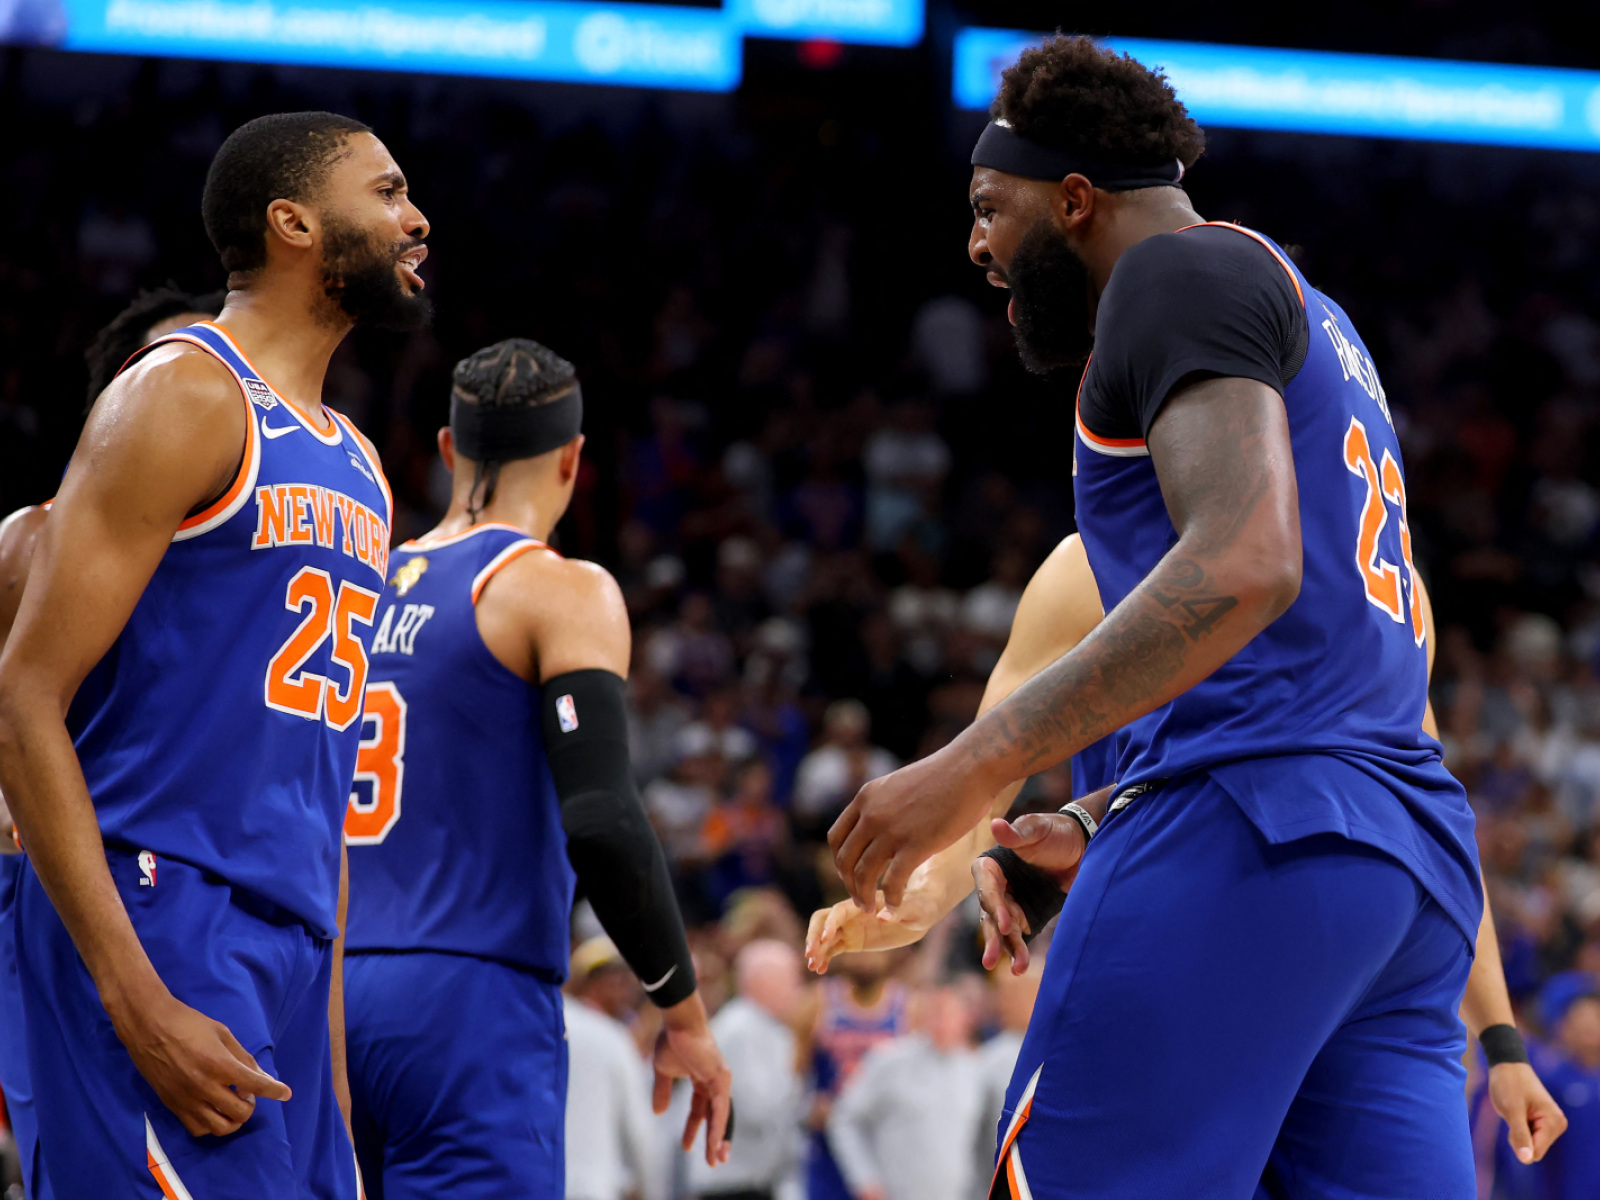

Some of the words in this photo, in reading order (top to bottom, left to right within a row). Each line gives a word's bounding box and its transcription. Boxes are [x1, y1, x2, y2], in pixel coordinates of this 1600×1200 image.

[251, 483, 336, 551] NEW
[1343, 414, 1426, 649] 23
[265, 565, 381, 733] 25
[371, 603, 436, 656] ART
[343, 680, 408, 846] 3
